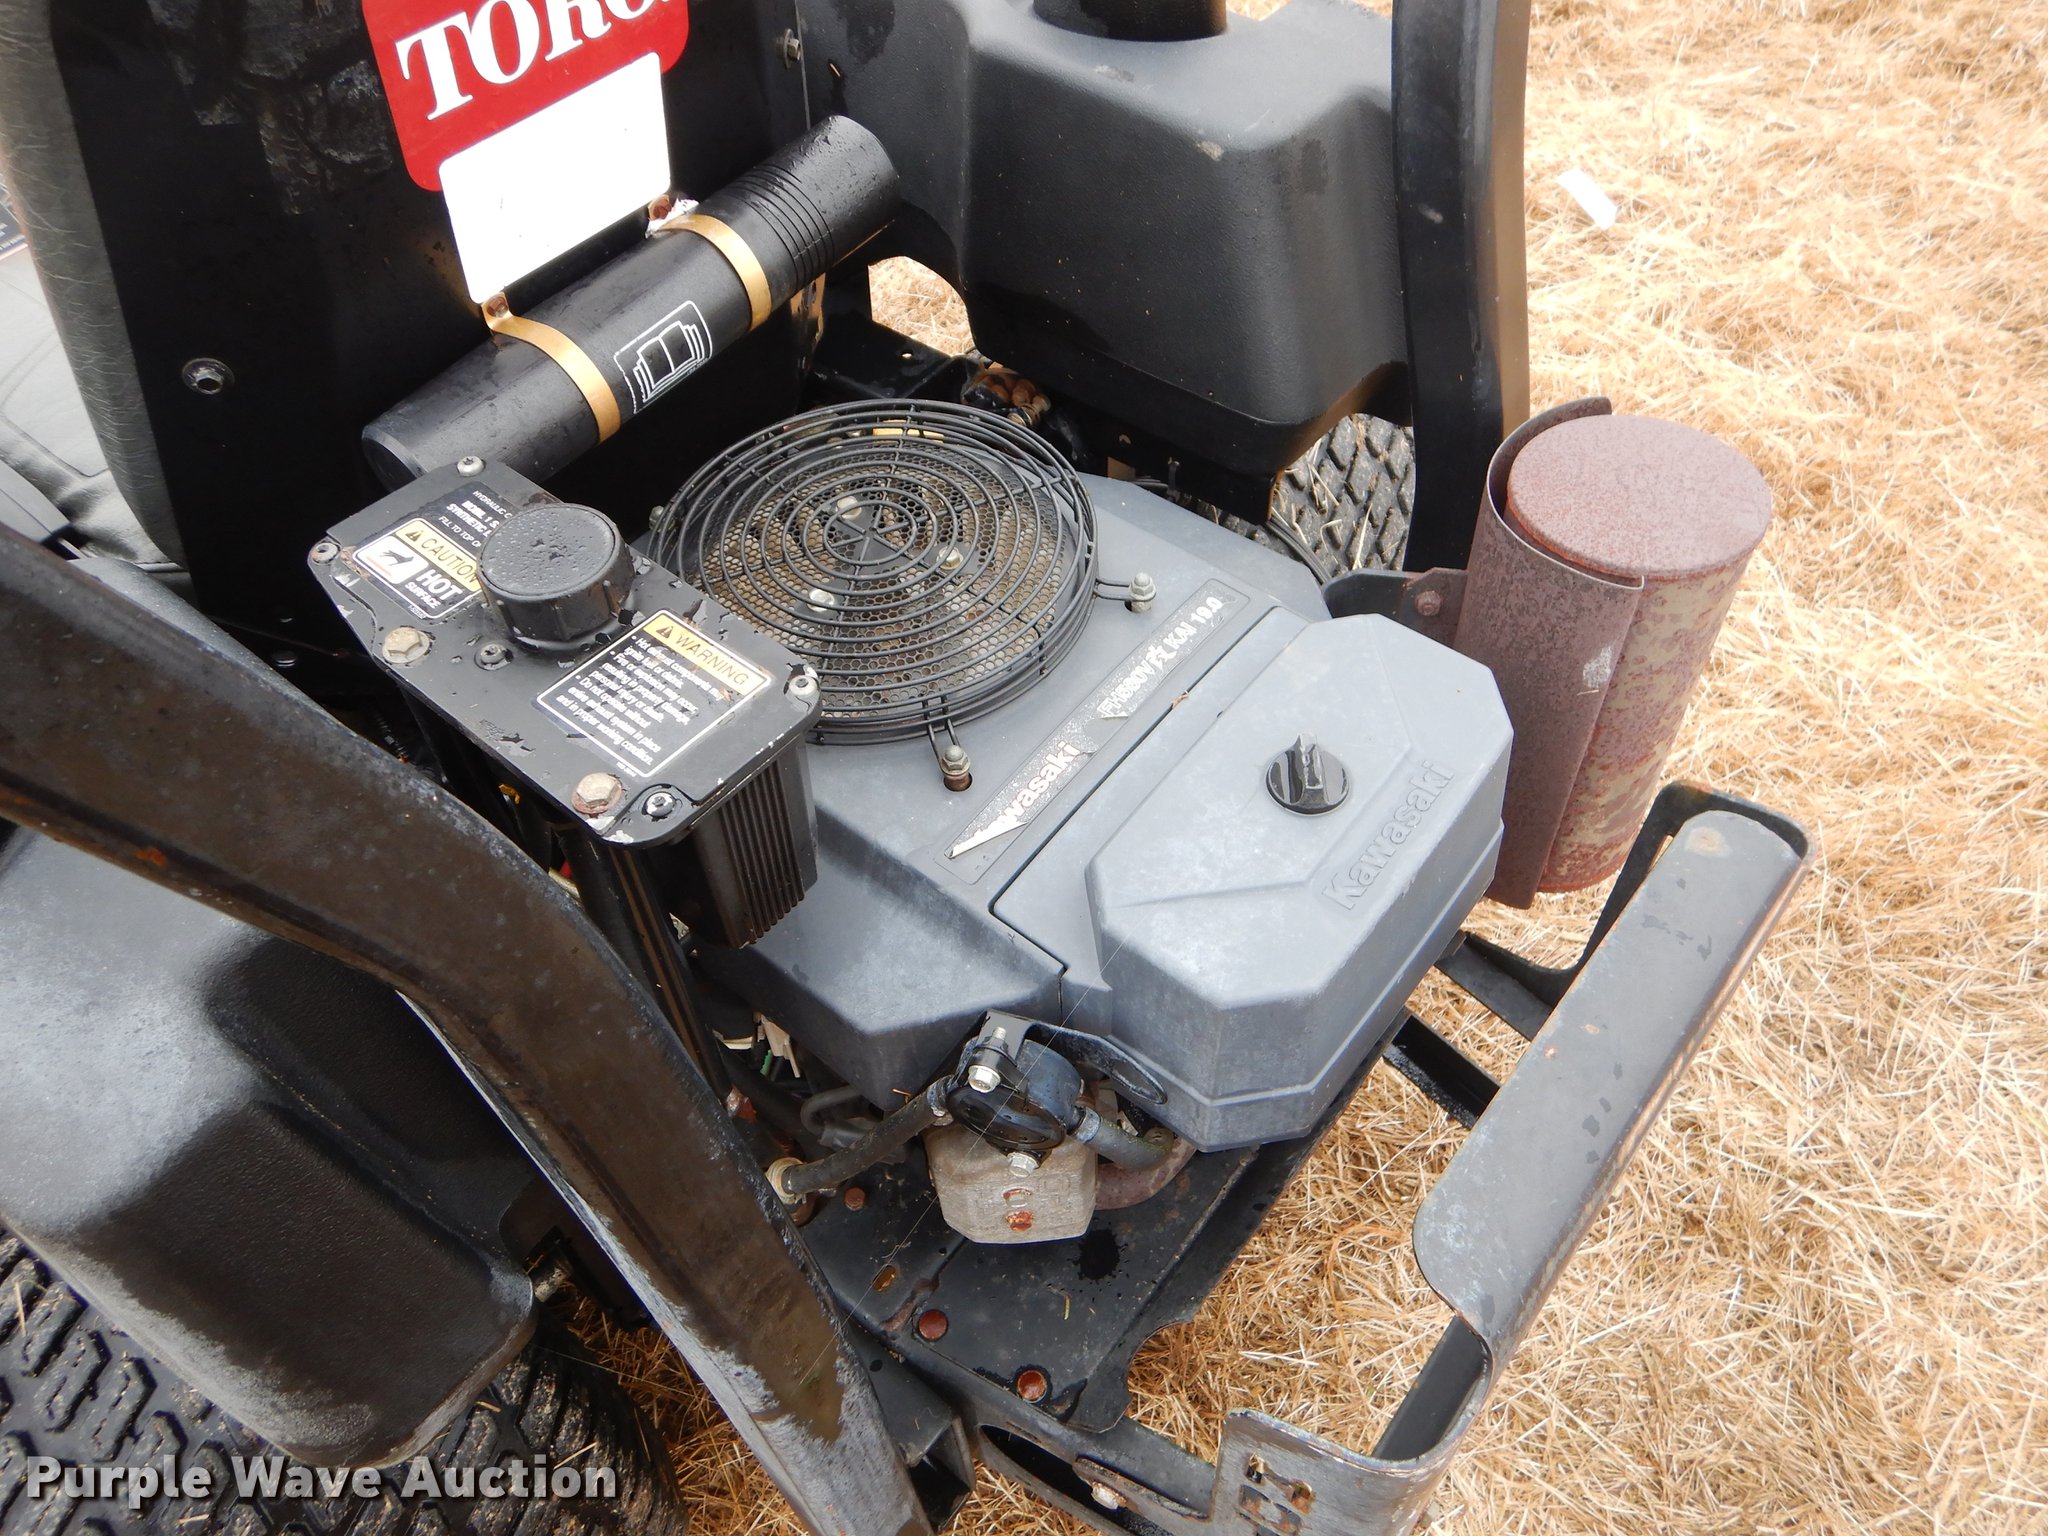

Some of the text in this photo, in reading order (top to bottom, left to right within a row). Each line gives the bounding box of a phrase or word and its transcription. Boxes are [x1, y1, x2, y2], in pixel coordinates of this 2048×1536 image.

[395, 0, 654, 120] TOR
[472, 490, 507, 515] HYDRAULIC
[437, 515, 454, 526] FILL
[450, 524, 462, 533] TO
[458, 531, 474, 542] TOP
[445, 503, 487, 532] SYNTHETIC
[421, 538, 478, 583] CAUTION
[404, 582, 441, 608] SURFACE
[415, 569, 463, 602] HOT
[1190, 595, 1223, 623] 19.0
[599, 661, 632, 684] resulting
[621, 645, 646, 662] ignite
[652, 666, 664, 674] or
[634, 637, 652, 649] Hot
[669, 662, 713, 691] components
[674, 634, 748, 684] WARNING
[588, 669, 622, 692] personal
[614, 687, 639, 705] injury
[633, 700, 646, 709] or
[612, 652, 631, 666] Fire
[625, 663, 637, 671] or
[631, 667, 667, 691] explosion
[660, 687, 680, 701] may
[627, 679, 639, 688] in
[555, 693, 574, 706] and
[567, 702, 580, 711] in
[578, 677, 652, 728] Do not operate without
[632, 684, 664, 707] property
[566, 685, 663, 753] entire exhaust system in place
[572, 707, 600, 728] proper
[594, 721, 625, 744] working
[1325, 759, 1454, 908] Kawasaki
